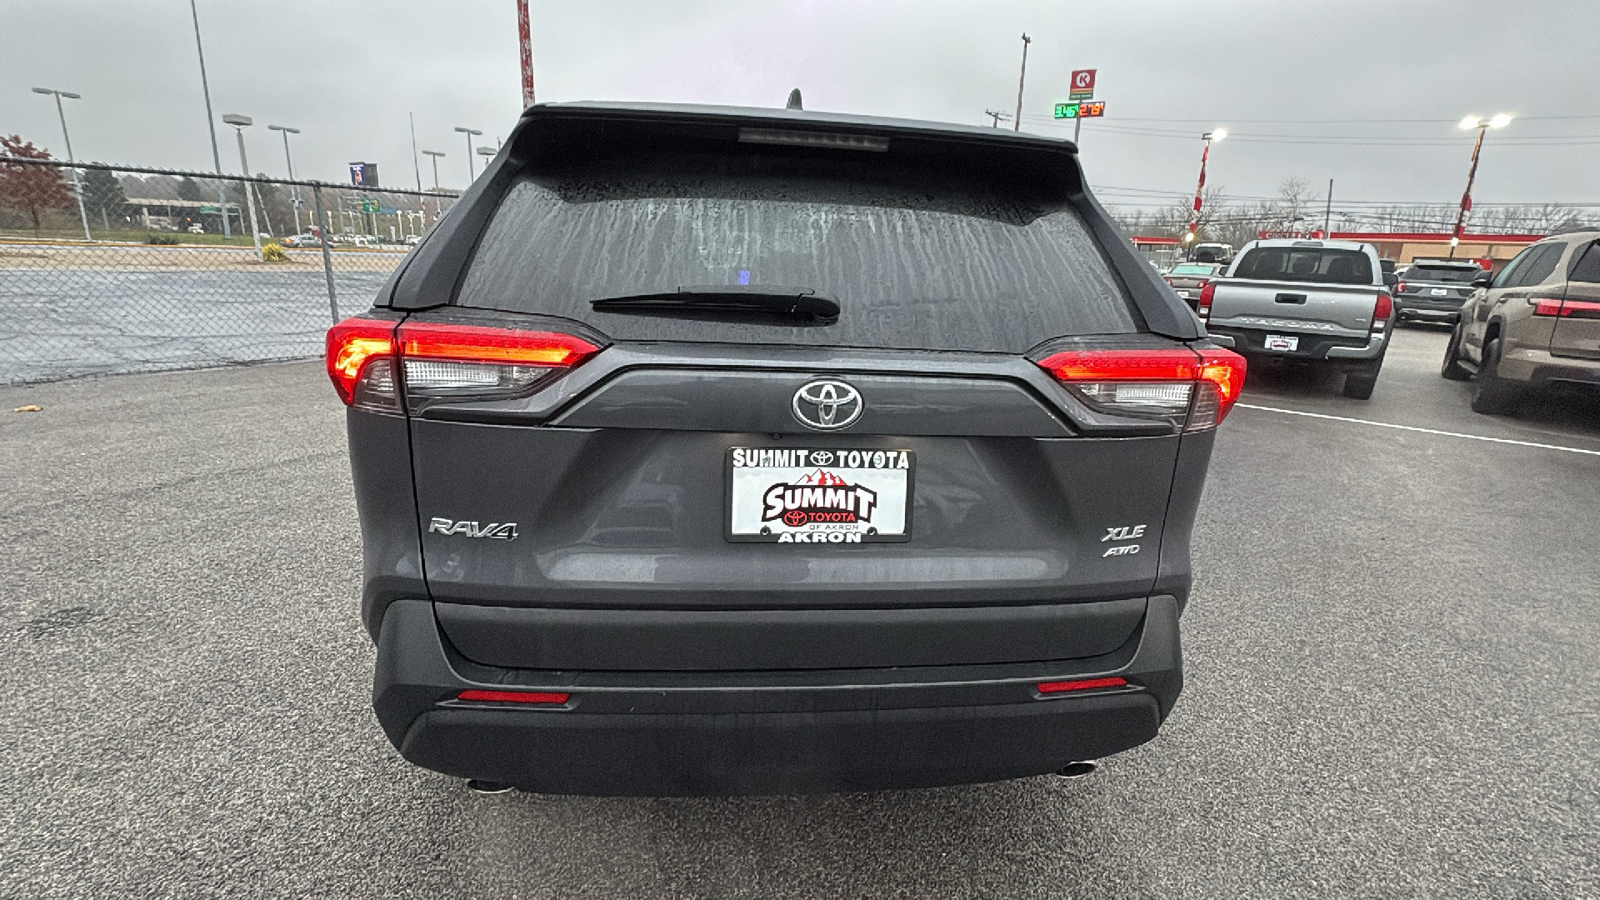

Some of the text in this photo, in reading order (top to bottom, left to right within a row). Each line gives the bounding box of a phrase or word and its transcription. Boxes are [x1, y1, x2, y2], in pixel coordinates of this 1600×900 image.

[1240, 317, 1335, 331] TACOMA
[732, 448, 909, 469] SUMMIT TOYOTA
[764, 484, 875, 520] SUMMIT
[809, 512, 856, 523] TOYOTA
[428, 517, 518, 541] RAV4
[778, 531, 862, 543] AKRON
[1101, 524, 1147, 542] XLE
[1102, 544, 1140, 557] AWD
